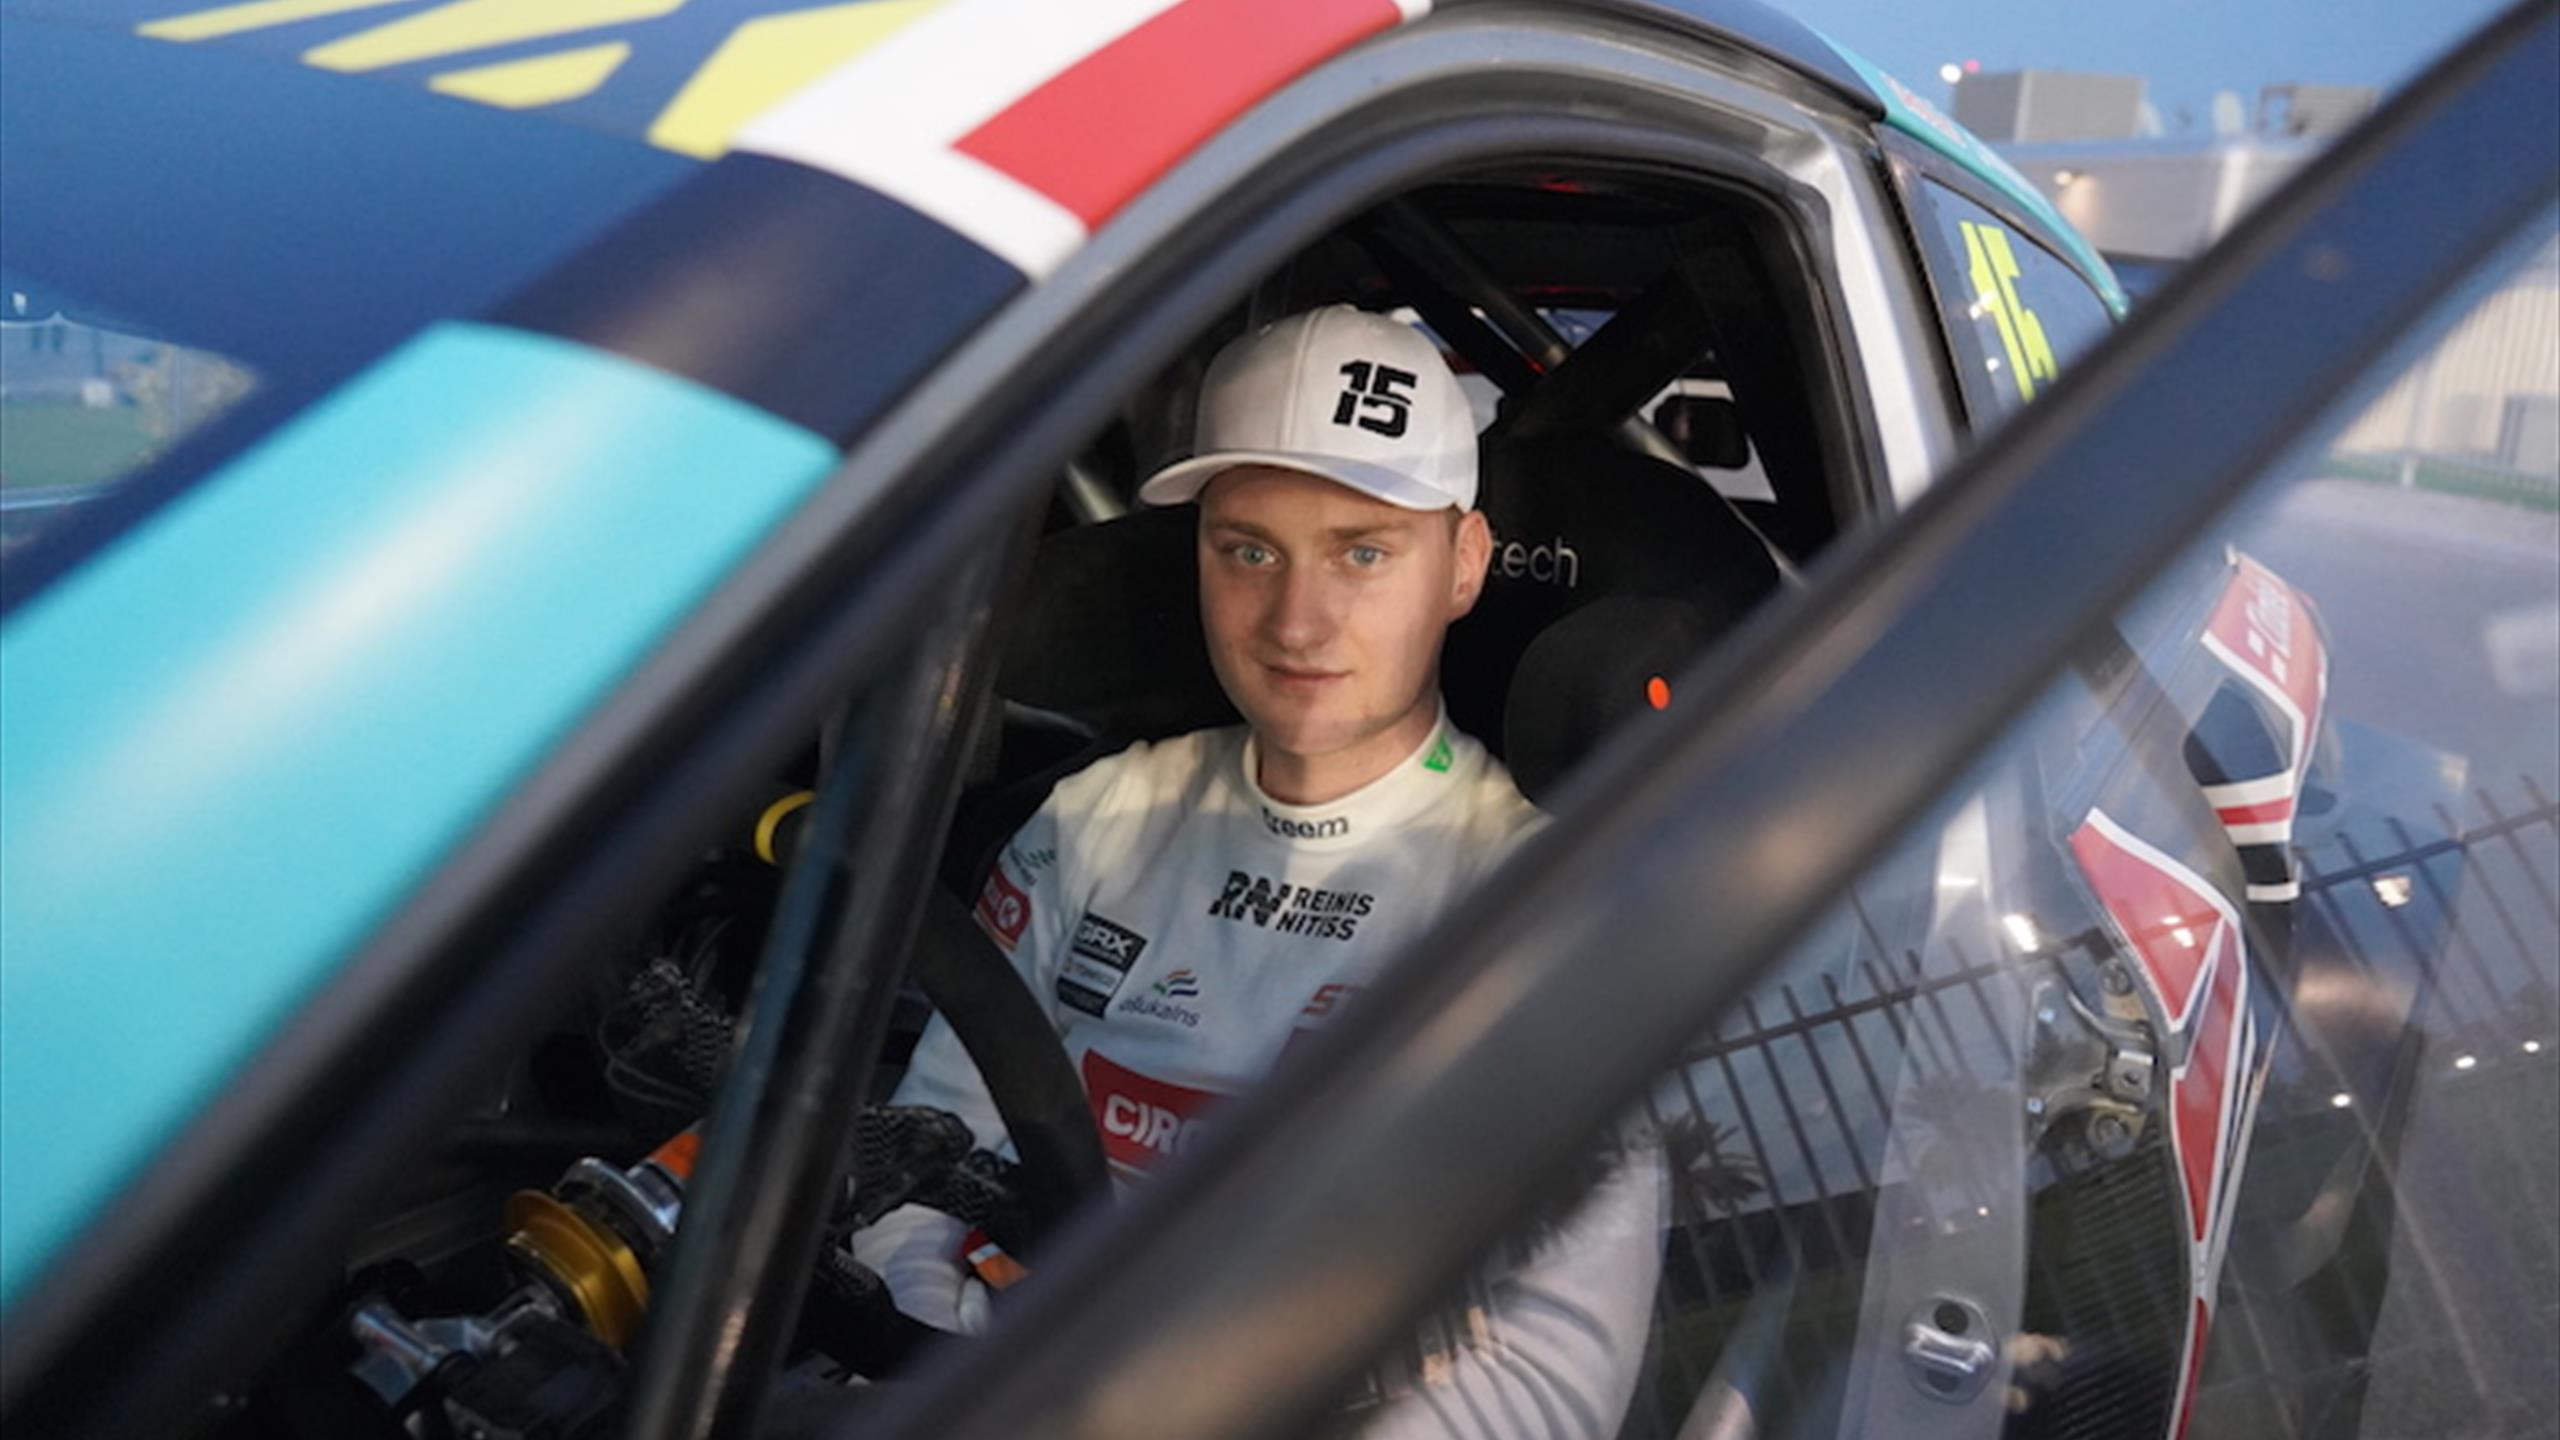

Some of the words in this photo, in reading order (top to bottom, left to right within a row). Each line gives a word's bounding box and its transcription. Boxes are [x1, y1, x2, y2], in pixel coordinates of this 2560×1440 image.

[1332, 359, 1418, 439] 15
[1292, 886, 1374, 916] REINIS
[1275, 910, 1358, 941] NITISS
